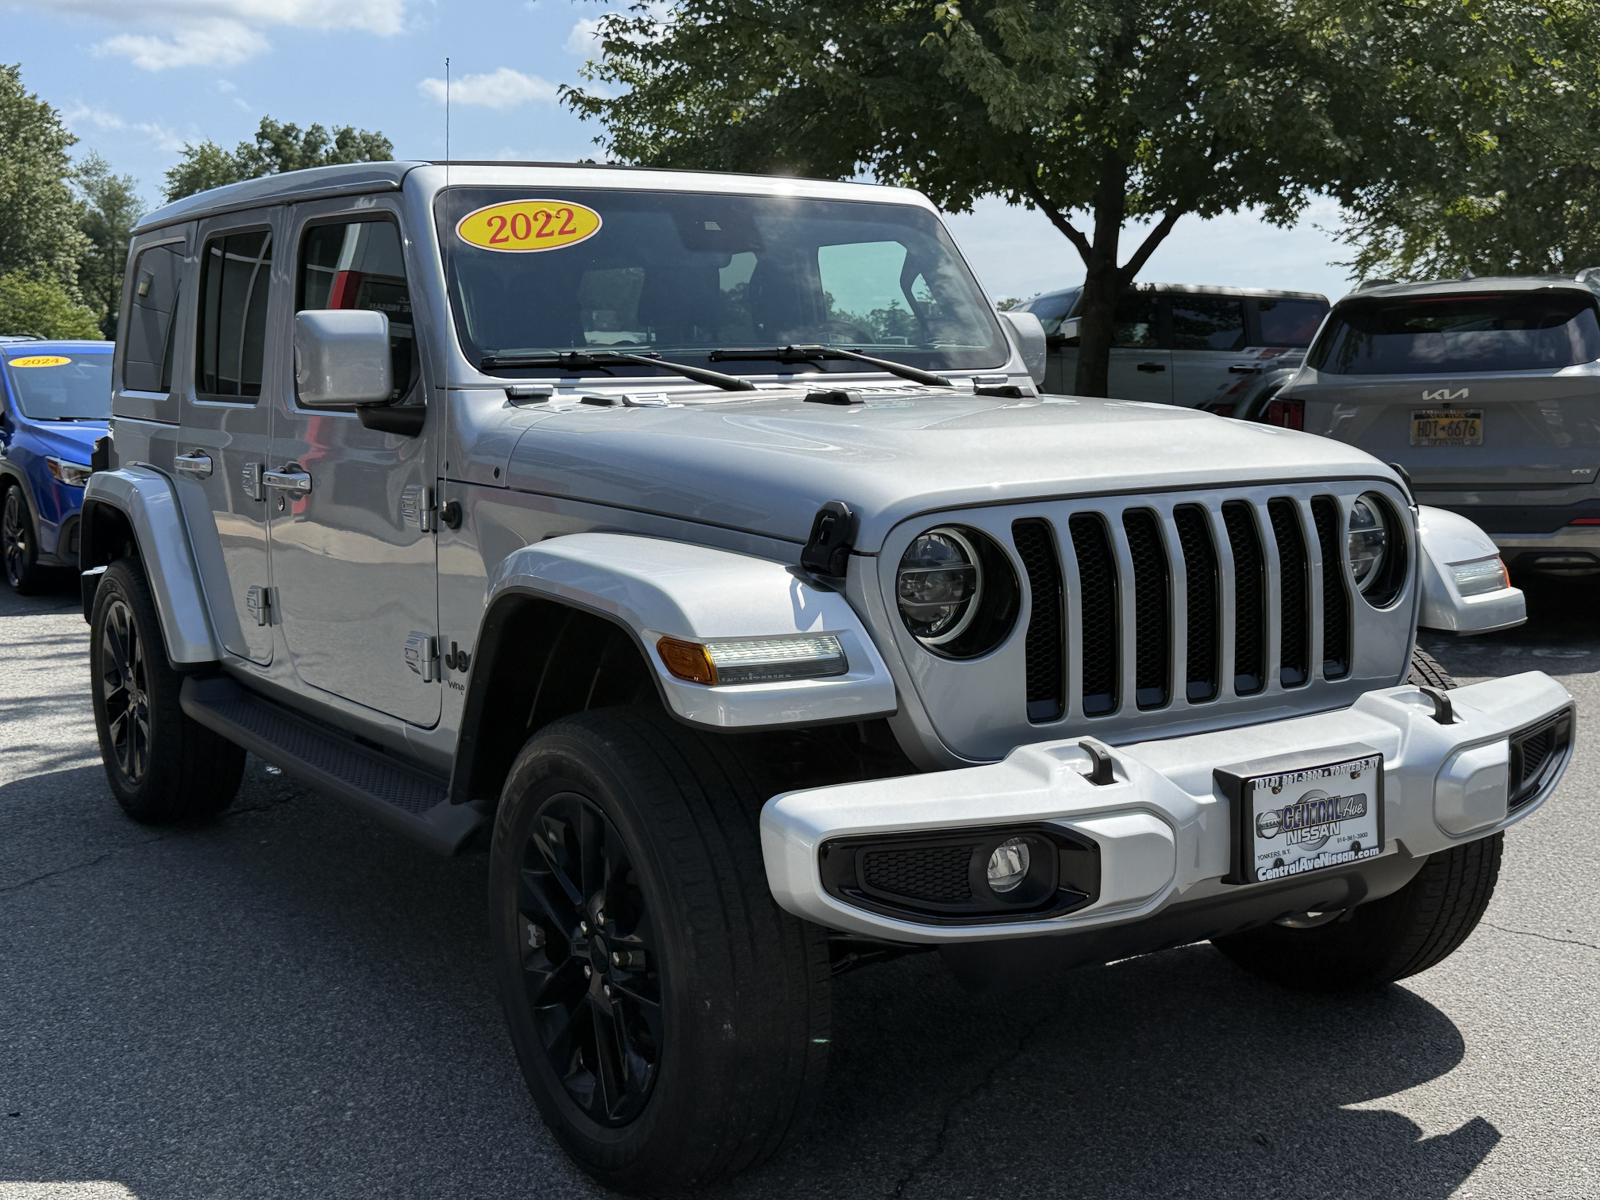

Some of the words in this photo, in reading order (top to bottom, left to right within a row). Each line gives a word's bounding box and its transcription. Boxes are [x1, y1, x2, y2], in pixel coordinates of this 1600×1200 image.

[487, 208, 577, 244] 2022
[22, 358, 59, 366] 2024
[1422, 387, 1469, 401] KIA
[1417, 420, 1439, 438] HDT
[1447, 419, 1476, 438] 6676
[1282, 795, 1341, 831] CENTRAL
[1343, 796, 1365, 818] Ave.
[1286, 822, 1341, 846] NISSAN
[1257, 847, 1379, 881] CentralAveNissan.com
